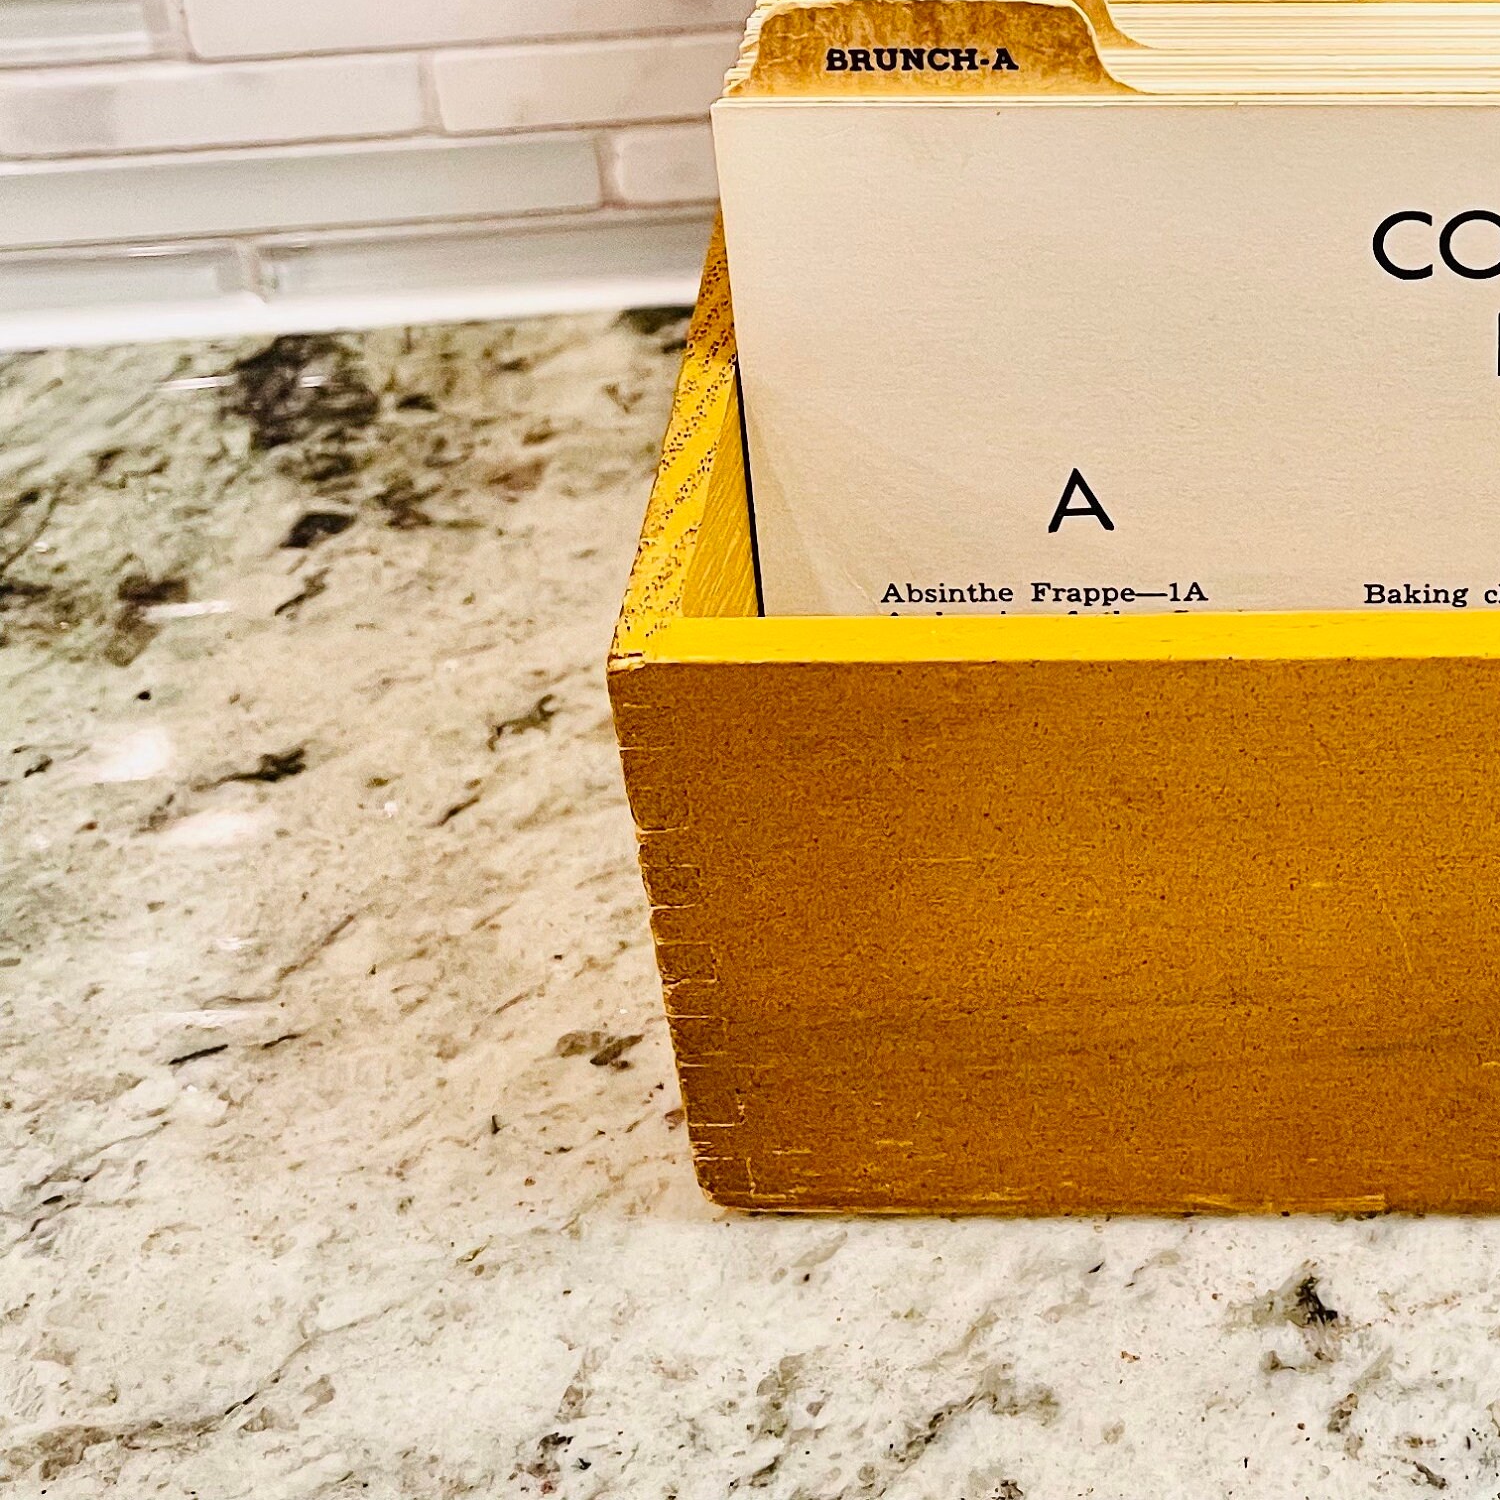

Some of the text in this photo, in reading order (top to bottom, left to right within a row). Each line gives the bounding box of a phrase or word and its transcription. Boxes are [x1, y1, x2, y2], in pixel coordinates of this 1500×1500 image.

[825, 47, 1020, 72] BRUNCH-A
[1048, 467, 1115, 534] A
[880, 582, 1014, 604] Absinthe
[1363, 583, 1469, 608] Baking
